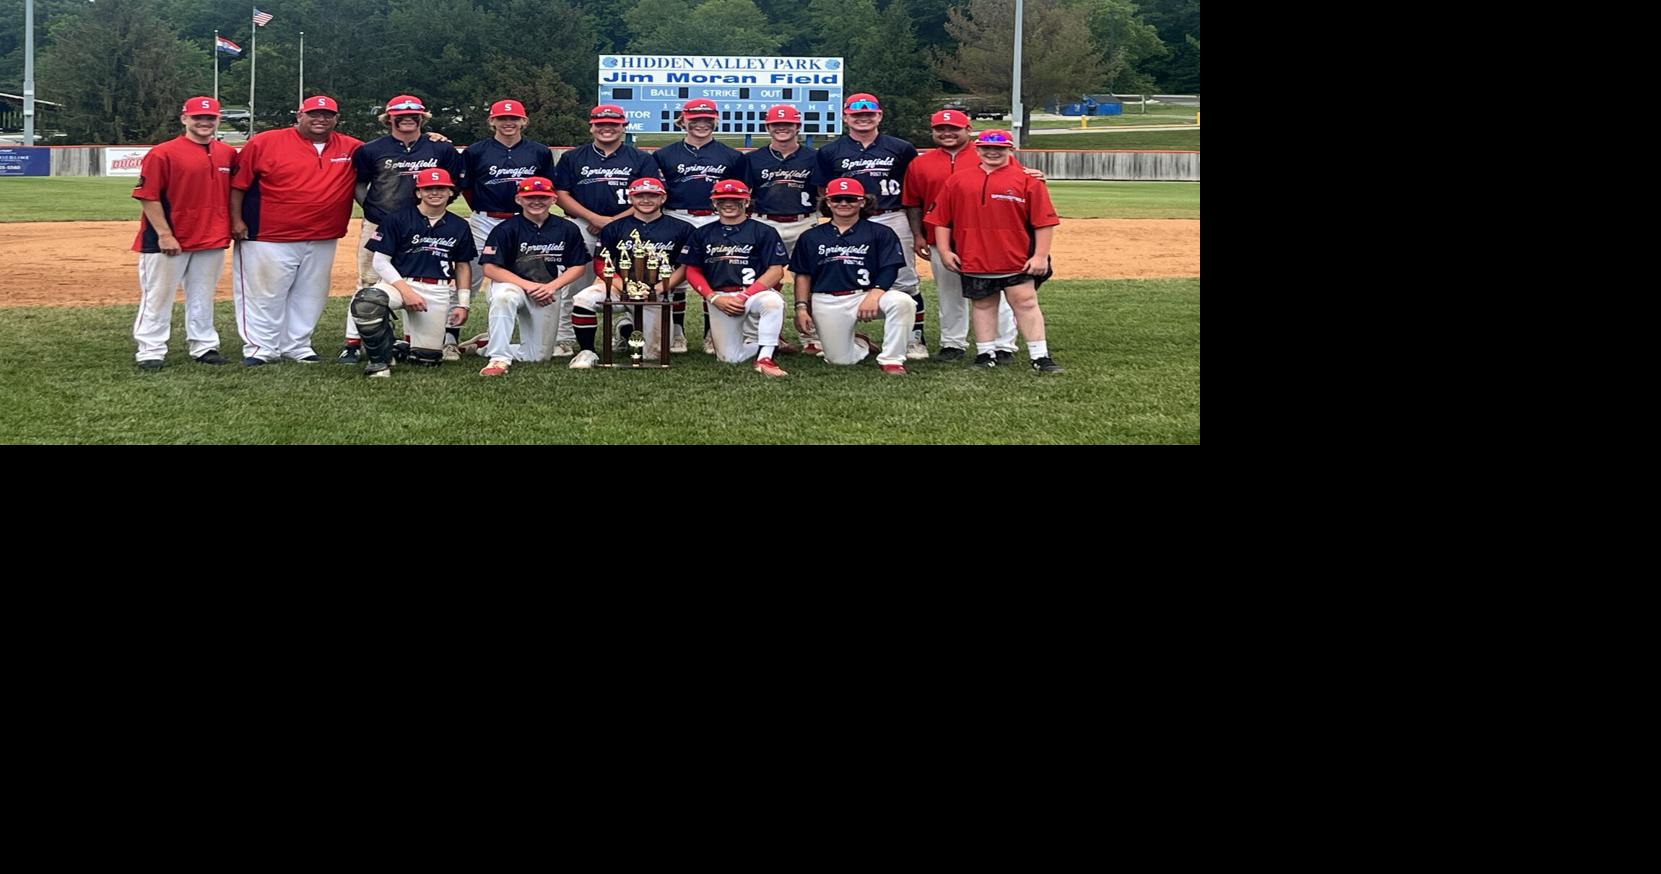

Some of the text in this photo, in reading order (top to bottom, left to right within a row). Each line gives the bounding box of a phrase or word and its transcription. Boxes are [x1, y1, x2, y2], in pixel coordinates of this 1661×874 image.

[621, 57, 822, 70] HIDDEN VALLEY PARK
[603, 72, 838, 84] Jim Moran Field
[202, 100, 210, 109] S
[318, 98, 326, 106] S
[504, 103, 512, 111] S
[777, 110, 785, 118] S
[943, 112, 951, 120] S
[384, 158, 438, 171] Springfield
[842, 156, 895, 170] Springfield
[489, 166, 537, 178] Springfield
[580, 166, 632, 178] Springfield
[677, 164, 726, 175] Springfield
[761, 168, 811, 180] Springfield
[432, 172, 440, 180] S
[840, 182, 848, 190] S
[879, 179, 900, 196] 10
[411, 234, 456, 248] Springfield
[706, 244, 754, 256] Springfield
[818, 244, 870, 256] Springfield
[741, 268, 756, 284] 2
[857, 268, 870, 286] 3
